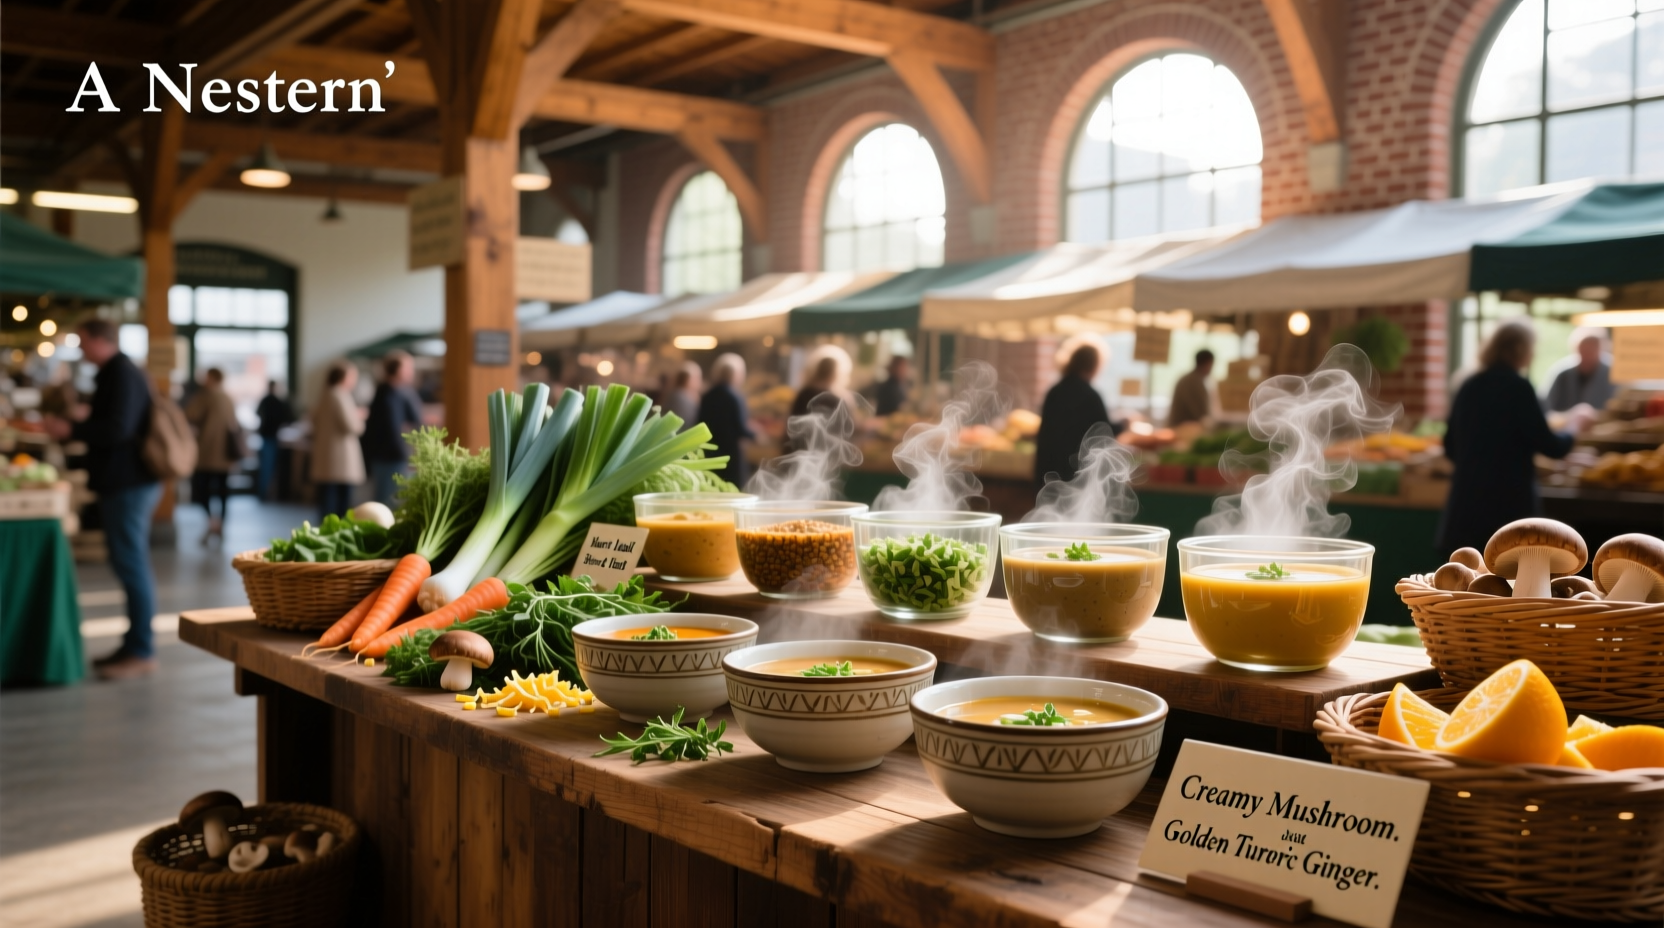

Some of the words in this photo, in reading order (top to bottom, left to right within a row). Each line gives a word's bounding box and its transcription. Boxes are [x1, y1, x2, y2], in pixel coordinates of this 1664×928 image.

[1181, 775, 1264, 818] Creamy
[1266, 791, 1399, 842] Mushroom.
[1164, 819, 1229, 854] Golden
[1302, 850, 1379, 891] Ginger.
